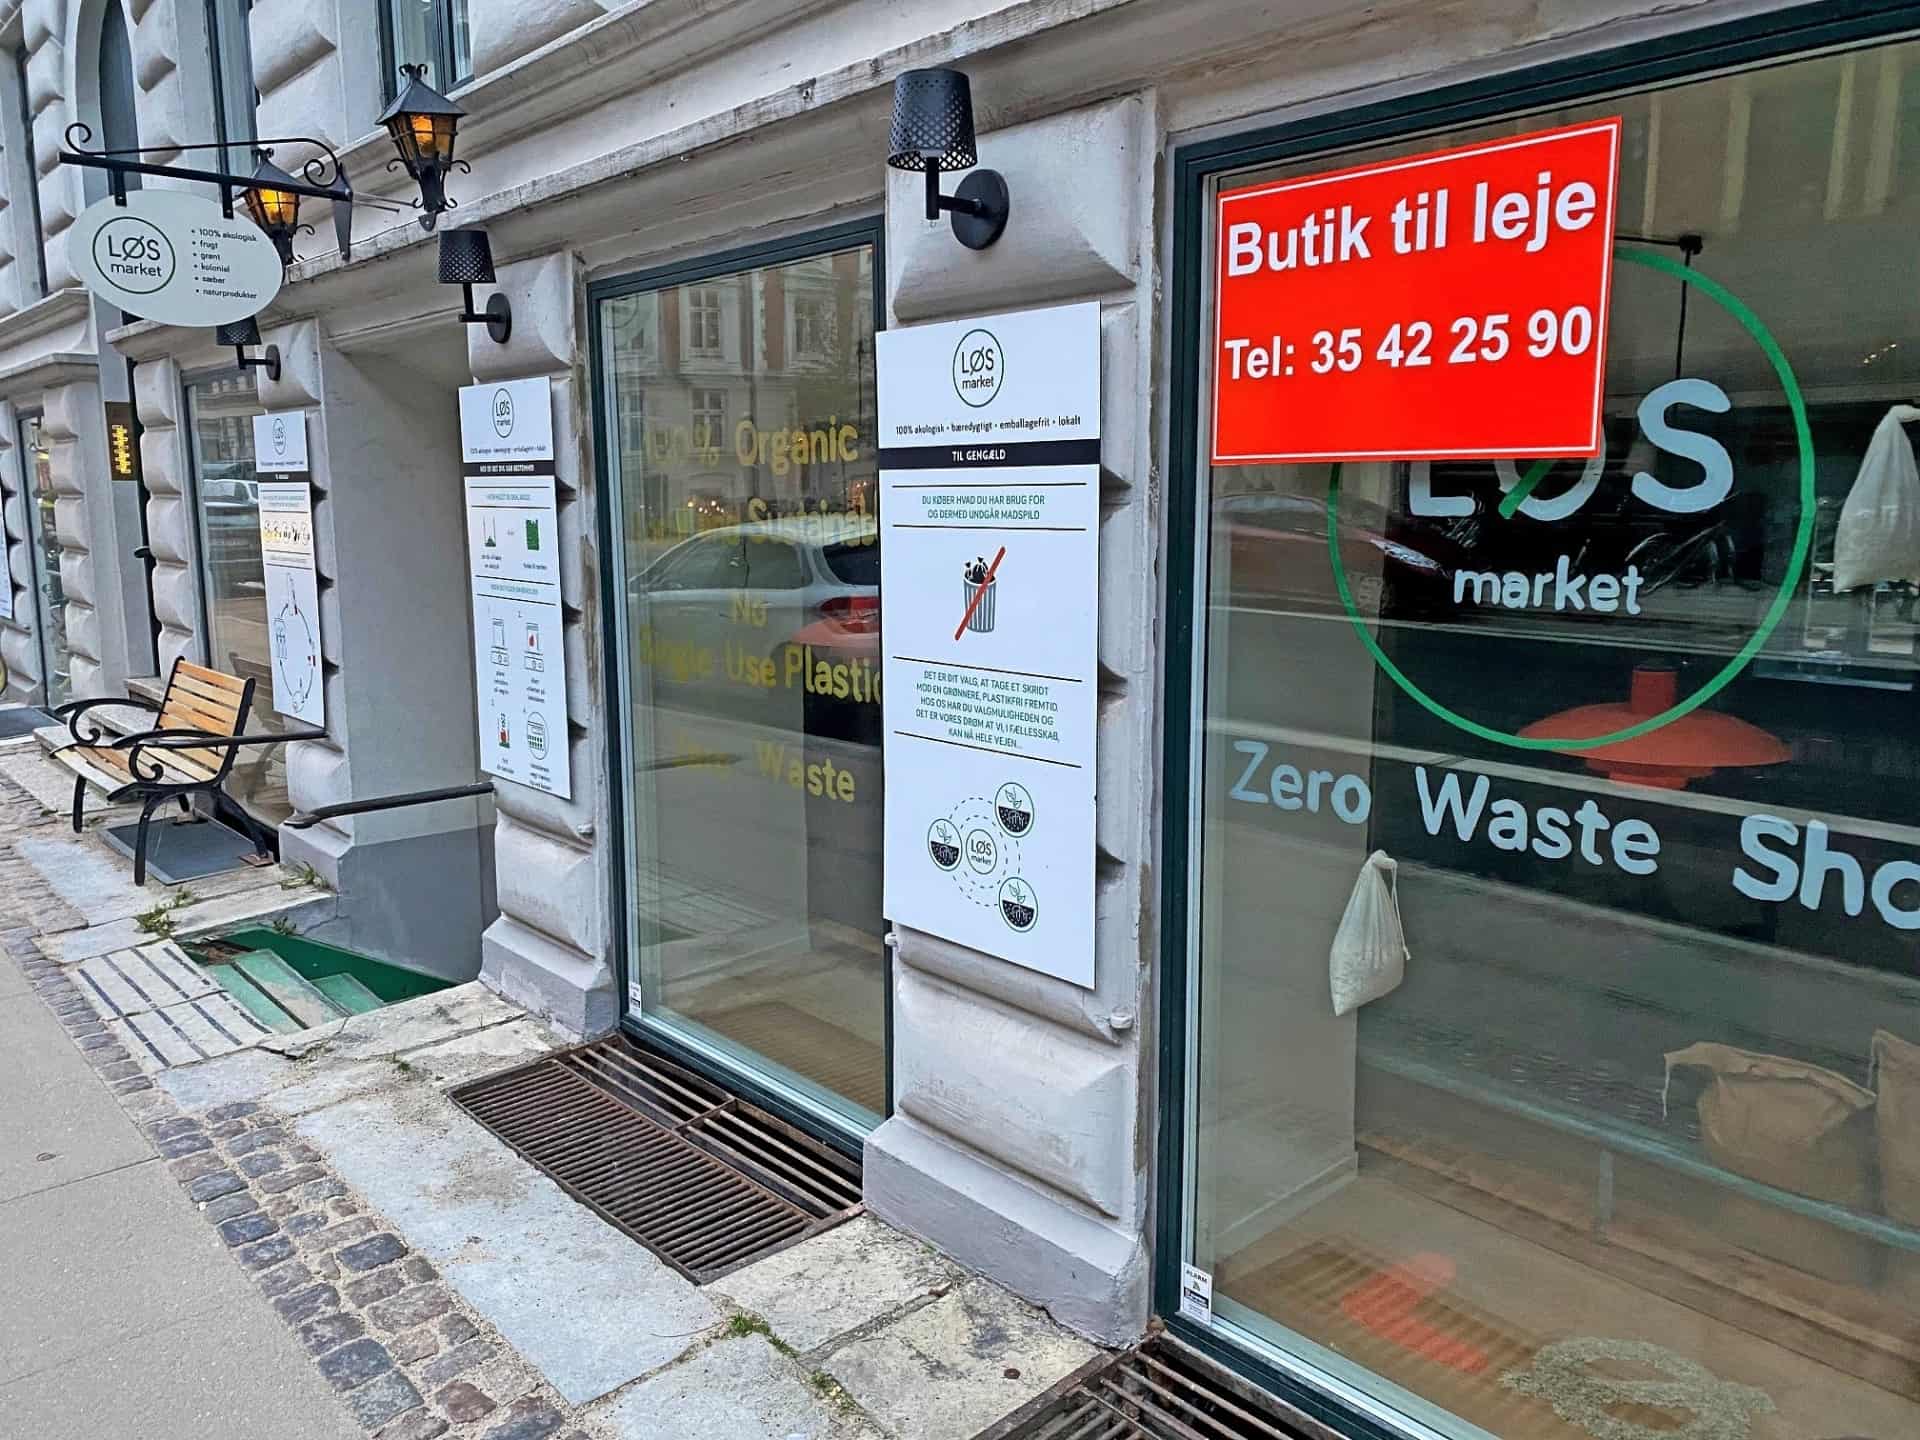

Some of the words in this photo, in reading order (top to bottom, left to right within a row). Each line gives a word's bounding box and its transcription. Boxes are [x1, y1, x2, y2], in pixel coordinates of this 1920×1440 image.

[1227, 205, 1372, 278] Butik
[1390, 188, 1449, 255] til
[1473, 171, 1597, 252] leje
[108, 235, 161, 261] LØS
[200, 239, 218, 250] frugt
[111, 262, 162, 278] market
[1224, 335, 1295, 380] Tel:
[1310, 328, 1362, 375] 35
[1376, 321, 1433, 369] 42
[1448, 314, 1510, 364] 25
[1527, 305, 1592, 358] 90
[961, 346, 995, 376] LØS
[961, 375, 995, 390] market
[896, 425, 913, 436] 100%
[914, 423, 945, 436] økologisk
[1000, 416, 1050, 431] emballagefrit
[1057, 415, 1081, 427] lokalt
[735, 415, 858, 476] Organic
[952, 450, 964, 462] TIL
[966, 449, 1006, 461] GENGÆLD
[922, 495, 932, 505] DU
[932, 495, 955, 505] KØBER
[956, 495, 976, 505] HVAD
[977, 495, 988, 505] DU
[989, 495, 1005, 505] HAR
[1006, 495, 1028, 505] BRUG
[1028, 494, 1045, 505] FOR
[927, 509, 939, 519] OG
[939, 509, 968, 519] DERMED
[969, 507, 1000, 520] UNDGÅR
[1001, 509, 1040, 520] MADSPILD
[1452, 554, 1645, 616] market
[726, 640, 777, 688] Use
[916, 683, 932, 692] MOD
[933, 685, 942, 694] EN
[982, 692, 1023, 707] PLASTIKFRI
[924, 670, 936, 680] DET
[938, 671, 947, 681] ER
[947, 673, 958, 683] DIT
[980, 679, 989, 688] AT
[991, 680, 1010, 691] TAGE
[1010, 682, 1020, 692] ET
[1022, 684, 1049, 696] SKRIDT
[915, 708, 928, 718] DET
[930, 711, 937, 721] ER
[939, 712, 962, 724] VORES
[963, 716, 984, 728] DRØM
[985, 720, 994, 729] AT
[920, 696, 935, 706] HOS
[935, 698, 946, 708] OS
[947, 700, 961, 711] HAR
[962, 703, 973, 712] DU
[974, 705, 1040, 724] VALGMULIGHEDEN
[1041, 715, 1054, 726] OG
[948, 727, 963, 737] KAN
[975, 732, 993, 743] HELE
[757, 741, 856, 803] Waste
[1229, 740, 1372, 825] Zero
[1415, 766, 1661, 875] Waste
[970, 839, 992, 856] LØS
